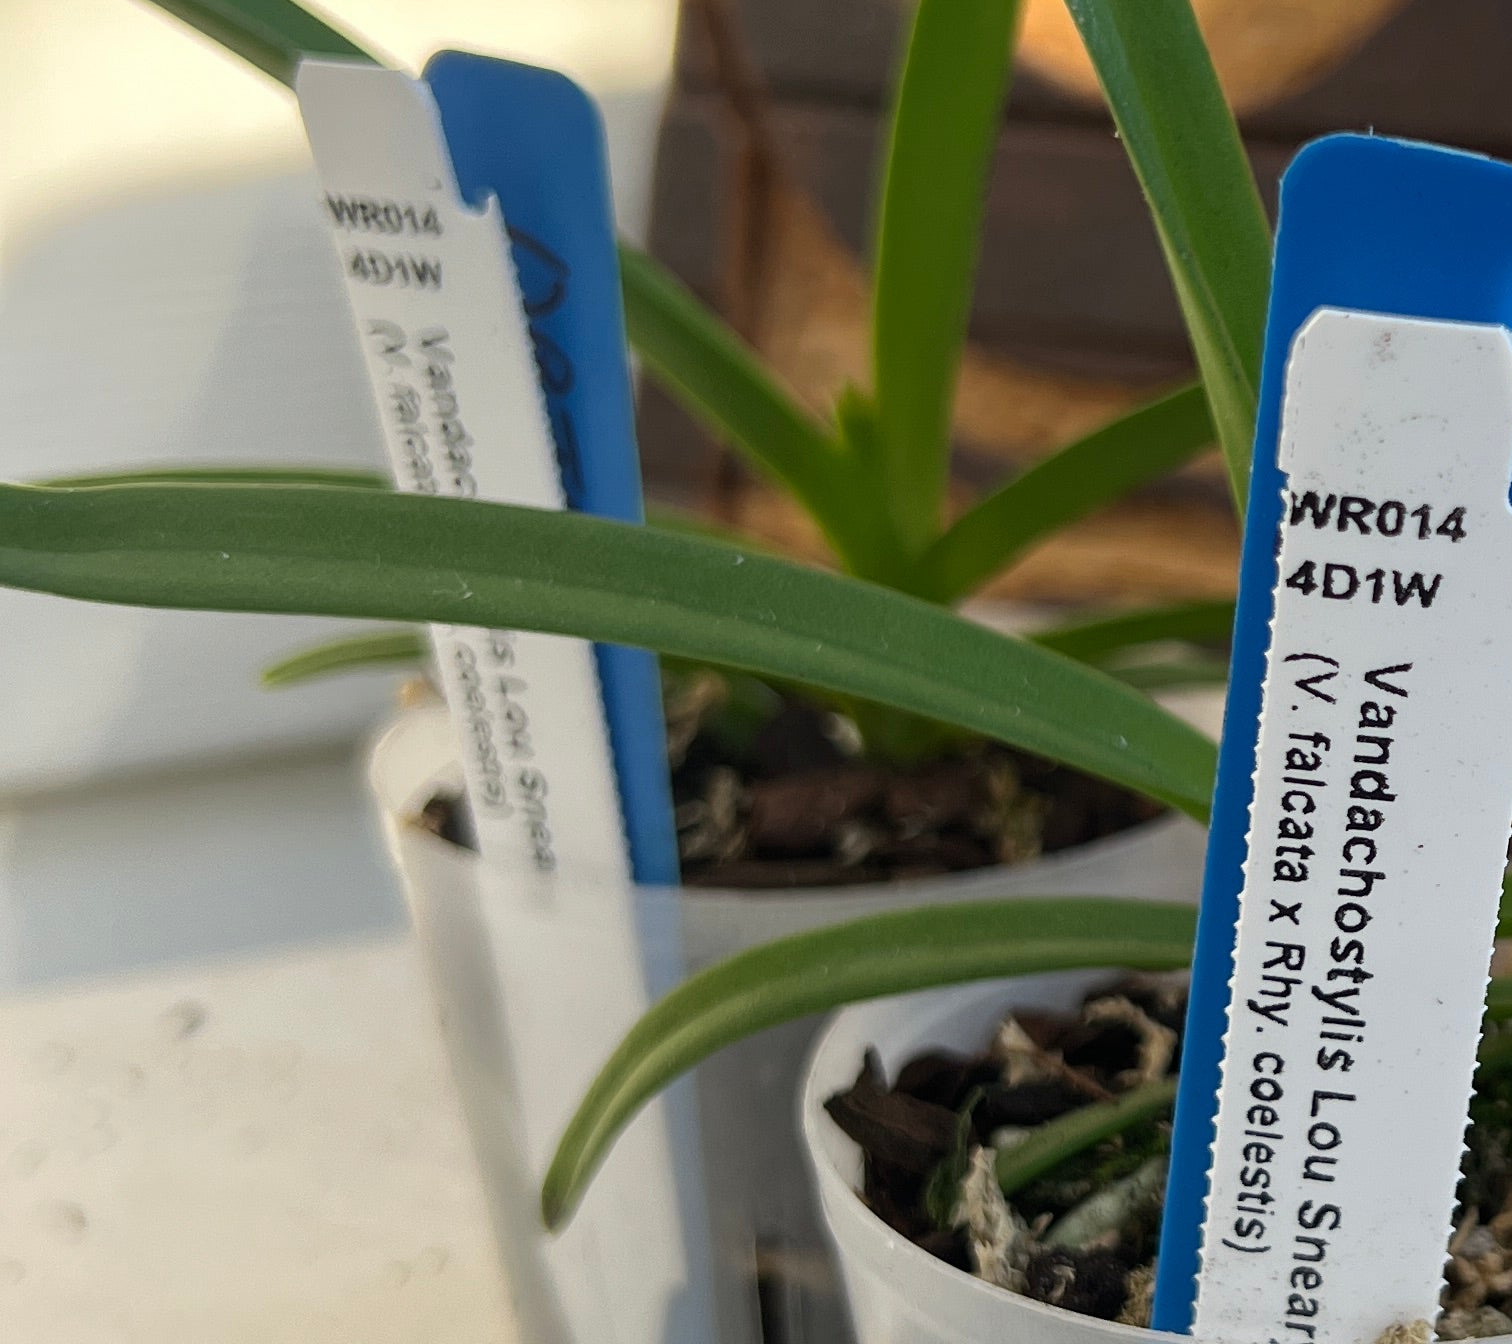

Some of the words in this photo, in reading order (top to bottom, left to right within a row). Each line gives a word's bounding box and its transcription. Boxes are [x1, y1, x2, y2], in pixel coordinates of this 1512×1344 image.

[325, 190, 443, 239] WR014
[351, 248, 443, 290] 4D1W
[1289, 491, 1467, 542] WR014
[1285, 562, 1444, 607] 4D1W
[1284, 652, 1340, 712] (V.
[1272, 730, 1330, 882] falcata
[1311, 662, 1413, 1072] Vandachostylis
[1268, 898, 1300, 927] x
[1246, 940, 1306, 1033] Rhy.
[1221, 1050, 1285, 1255] coelestis)
[1300, 1090, 1356, 1182] Lou
